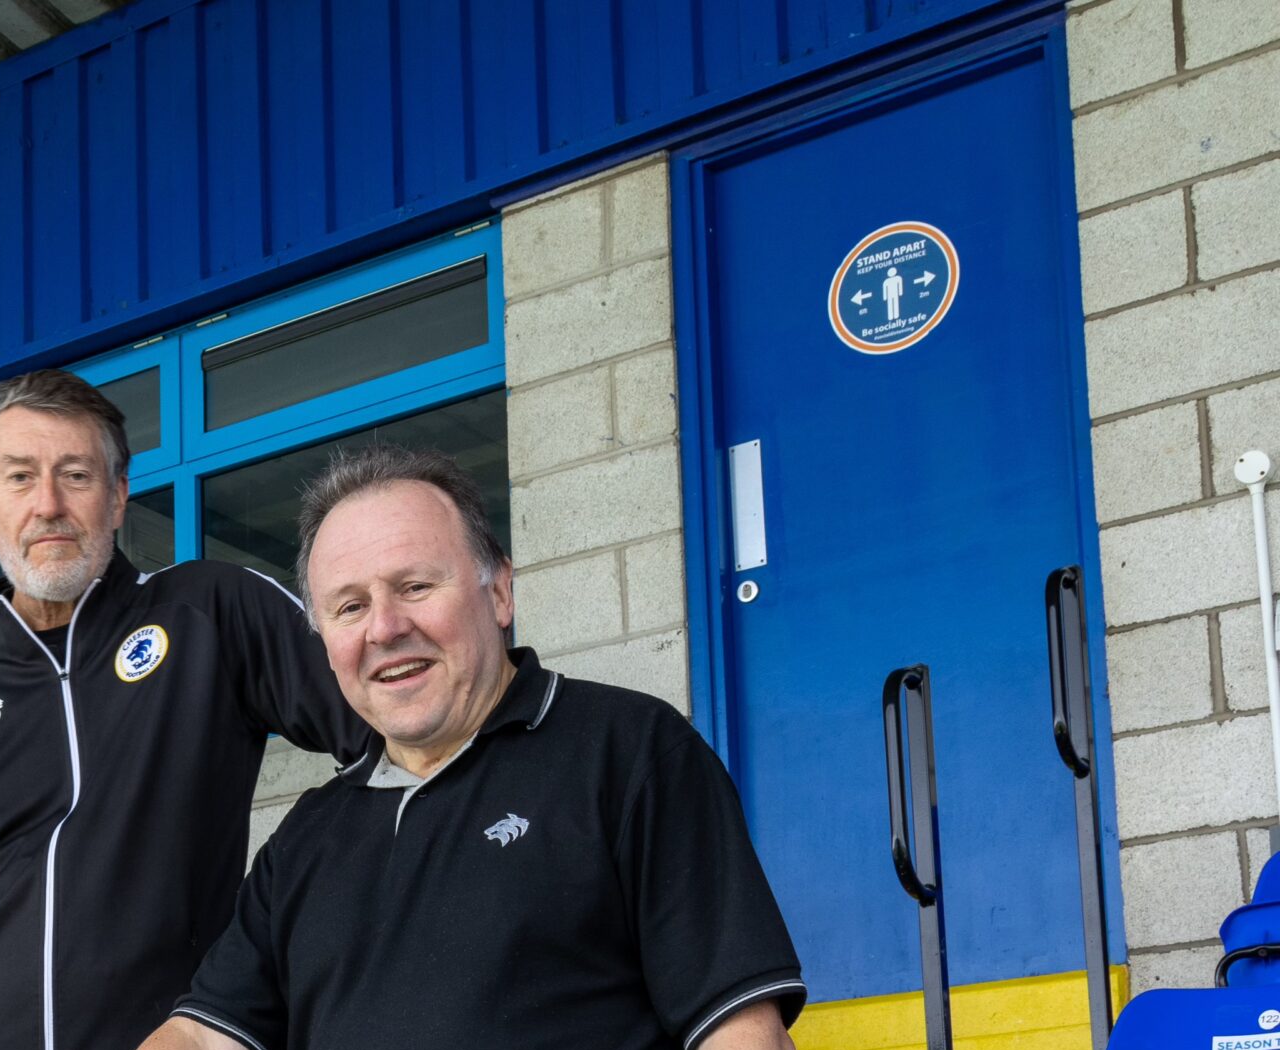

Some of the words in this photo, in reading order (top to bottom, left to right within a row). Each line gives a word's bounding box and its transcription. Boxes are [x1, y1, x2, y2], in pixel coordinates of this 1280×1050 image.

[857, 250, 891, 268] STAND
[892, 239, 927, 257] APART
[857, 266, 873, 275] KEEP
[875, 260, 892, 271] YOUR
[894, 249, 926, 265] DISTANCE
[862, 328, 873, 337] Be
[874, 319, 907, 334] socially
[908, 312, 927, 324] safe
[122, 628, 154, 651] CHESTER
[1261, 1015, 1279, 1024] 122
[1217, 1039, 1272, 1050] SEASON
